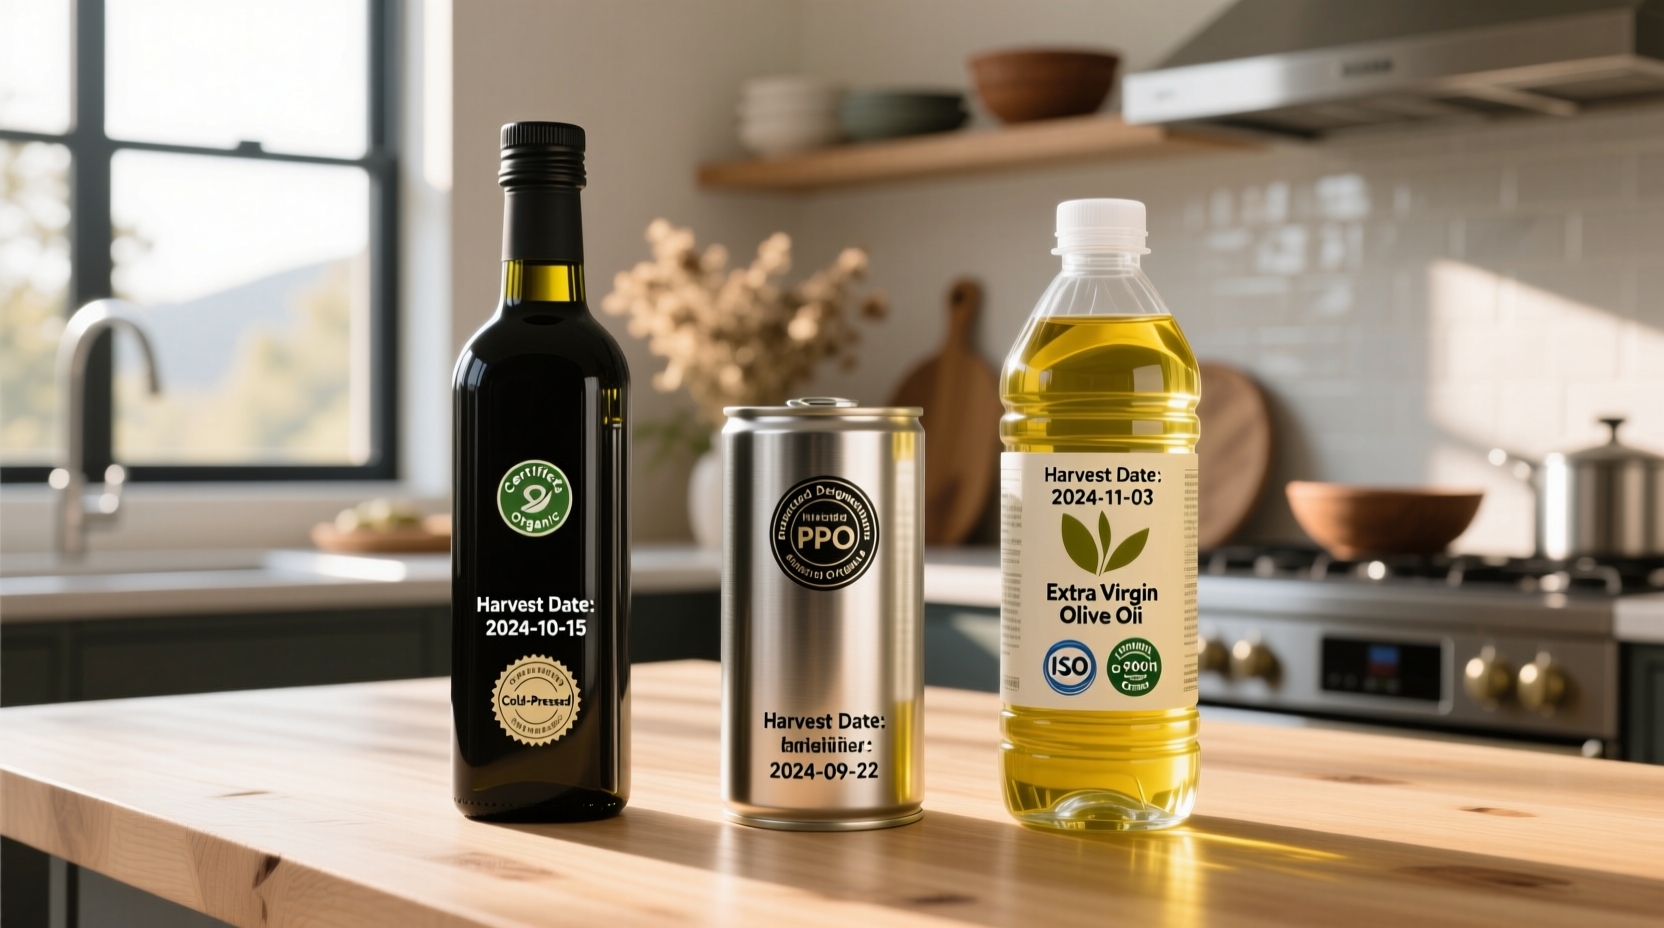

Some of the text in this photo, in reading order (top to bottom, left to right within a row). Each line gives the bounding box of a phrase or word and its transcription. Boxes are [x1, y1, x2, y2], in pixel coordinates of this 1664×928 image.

[1044, 466, 1161, 483] Harvest Date:
[1051, 488, 1154, 506] 2024-11-03
[511, 511, 560, 532] Organic
[798, 525, 855, 550] PPO
[1046, 582, 1158, 606] Extra Virgin
[477, 596, 595, 613] Harvest Date:
[1059, 605, 1111, 625] Olive
[485, 619, 587, 637] 2024-10-15
[1051, 656, 1089, 677] ISO
[764, 711, 886, 729] Harvest Date:
[769, 761, 879, 780] 2024-09-22
